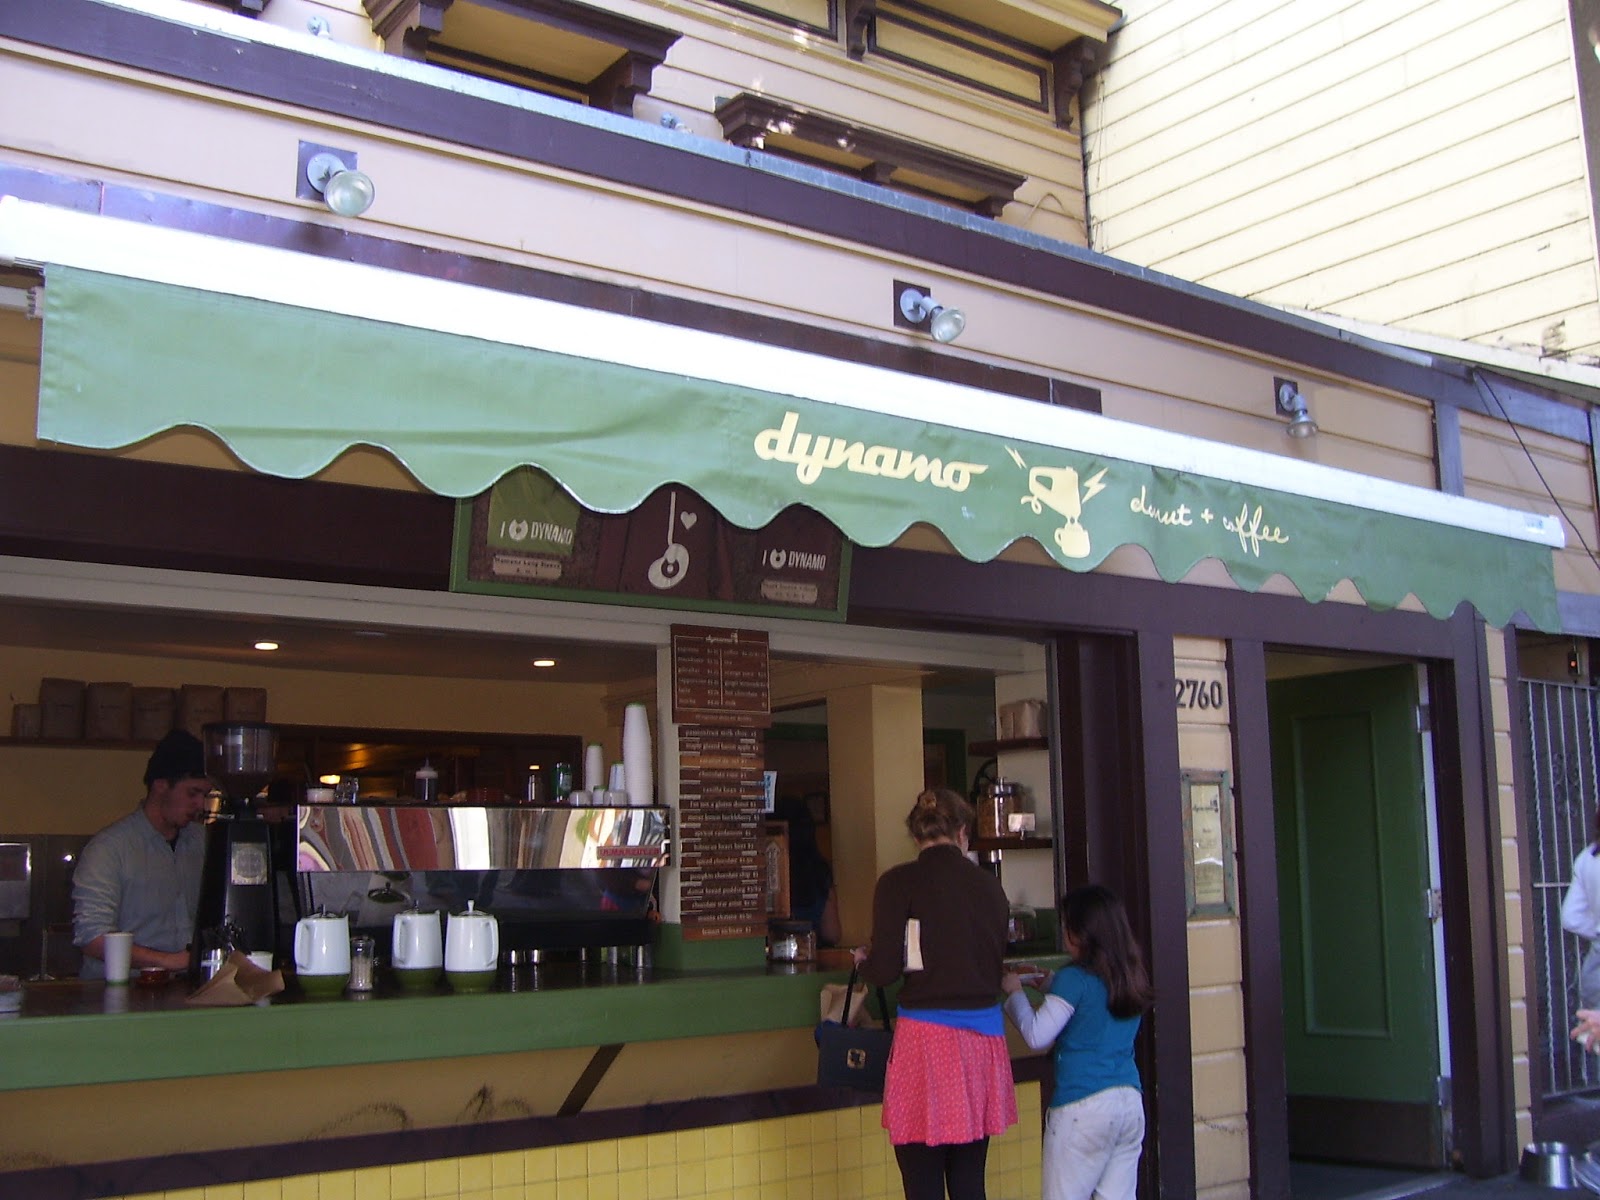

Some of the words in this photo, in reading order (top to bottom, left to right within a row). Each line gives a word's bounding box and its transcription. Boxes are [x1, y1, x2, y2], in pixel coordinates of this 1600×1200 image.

[754, 411, 988, 492] dynamo
[531, 521, 573, 545] DYNAMO
[788, 551, 826, 571] DYNAMO
[1174, 679, 1222, 709] 2760
